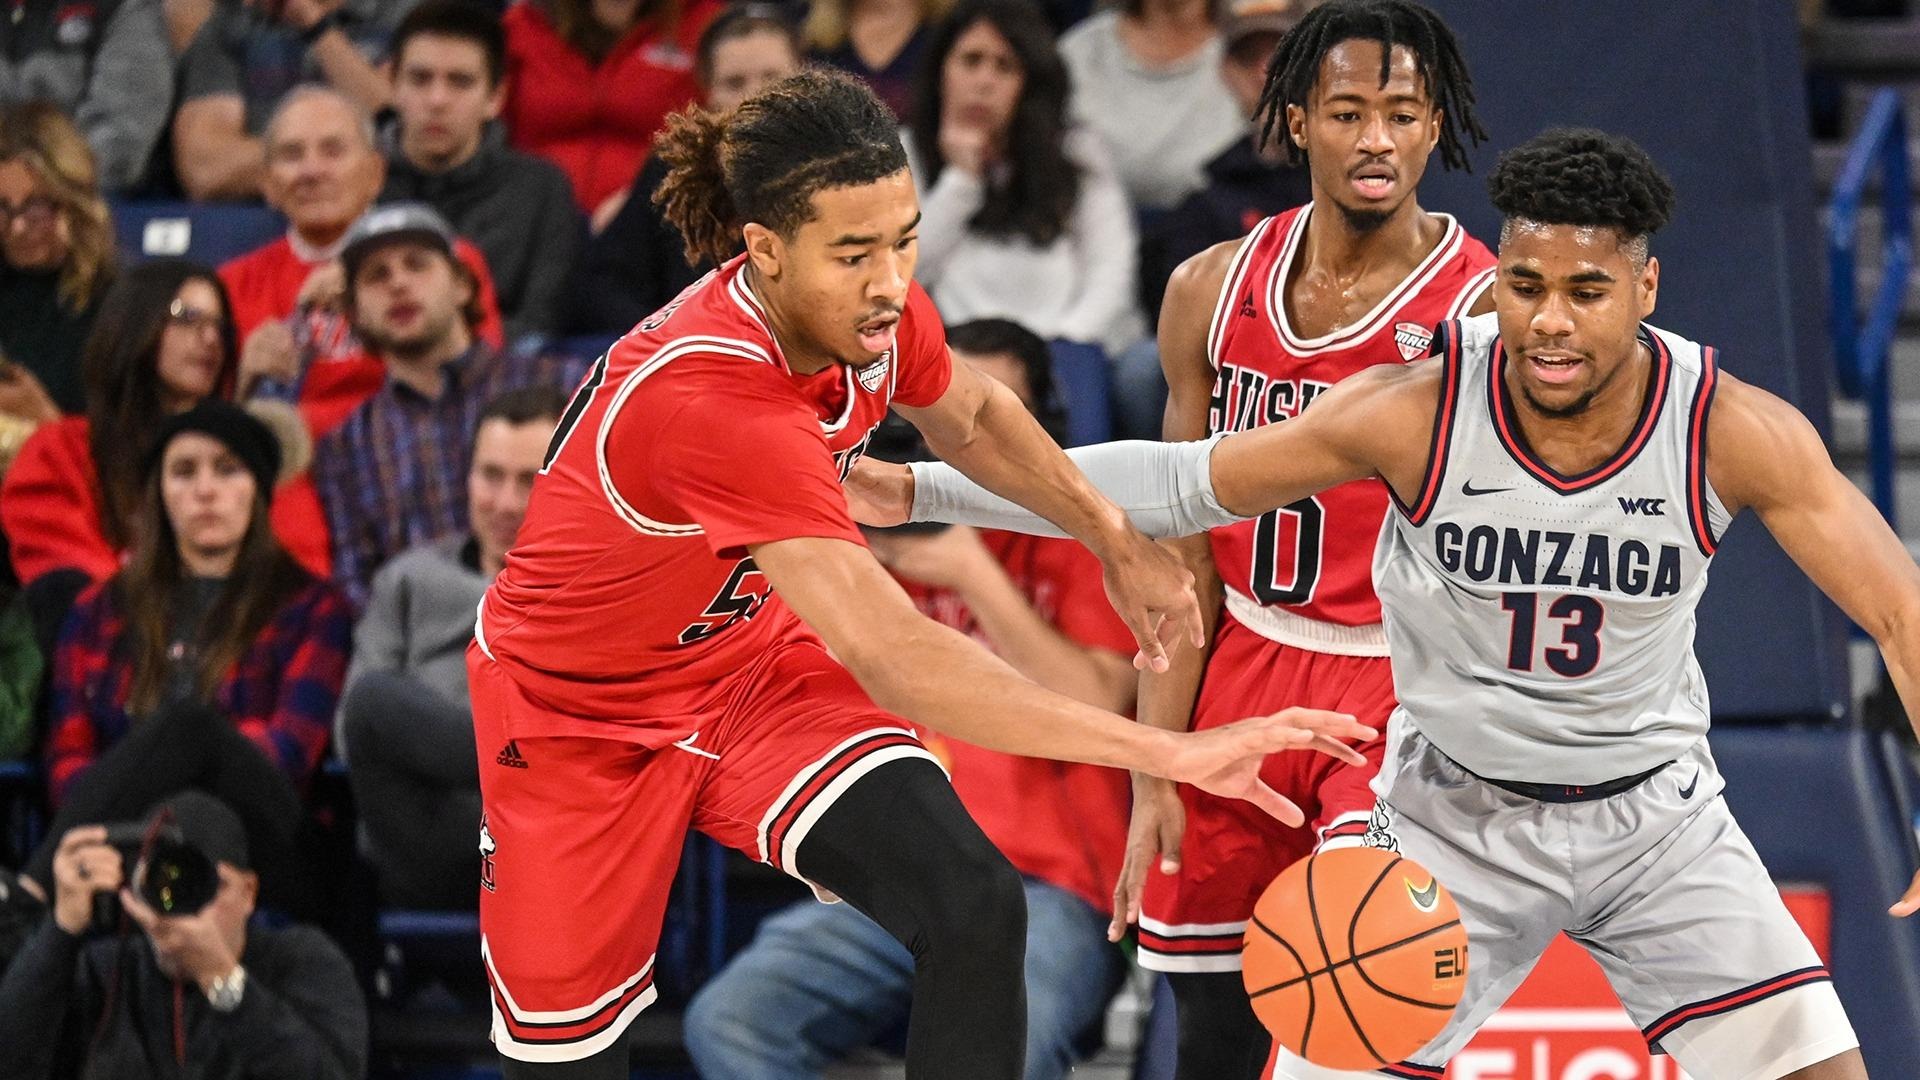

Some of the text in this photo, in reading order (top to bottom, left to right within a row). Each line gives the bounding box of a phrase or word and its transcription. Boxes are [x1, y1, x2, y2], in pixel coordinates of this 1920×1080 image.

[1394, 330, 1431, 350] MAC
[1617, 497, 1666, 515] WCC
[1435, 522, 1681, 597] GONZAGA
[678, 556, 774, 644] 5
[1501, 592, 1604, 678] 13
